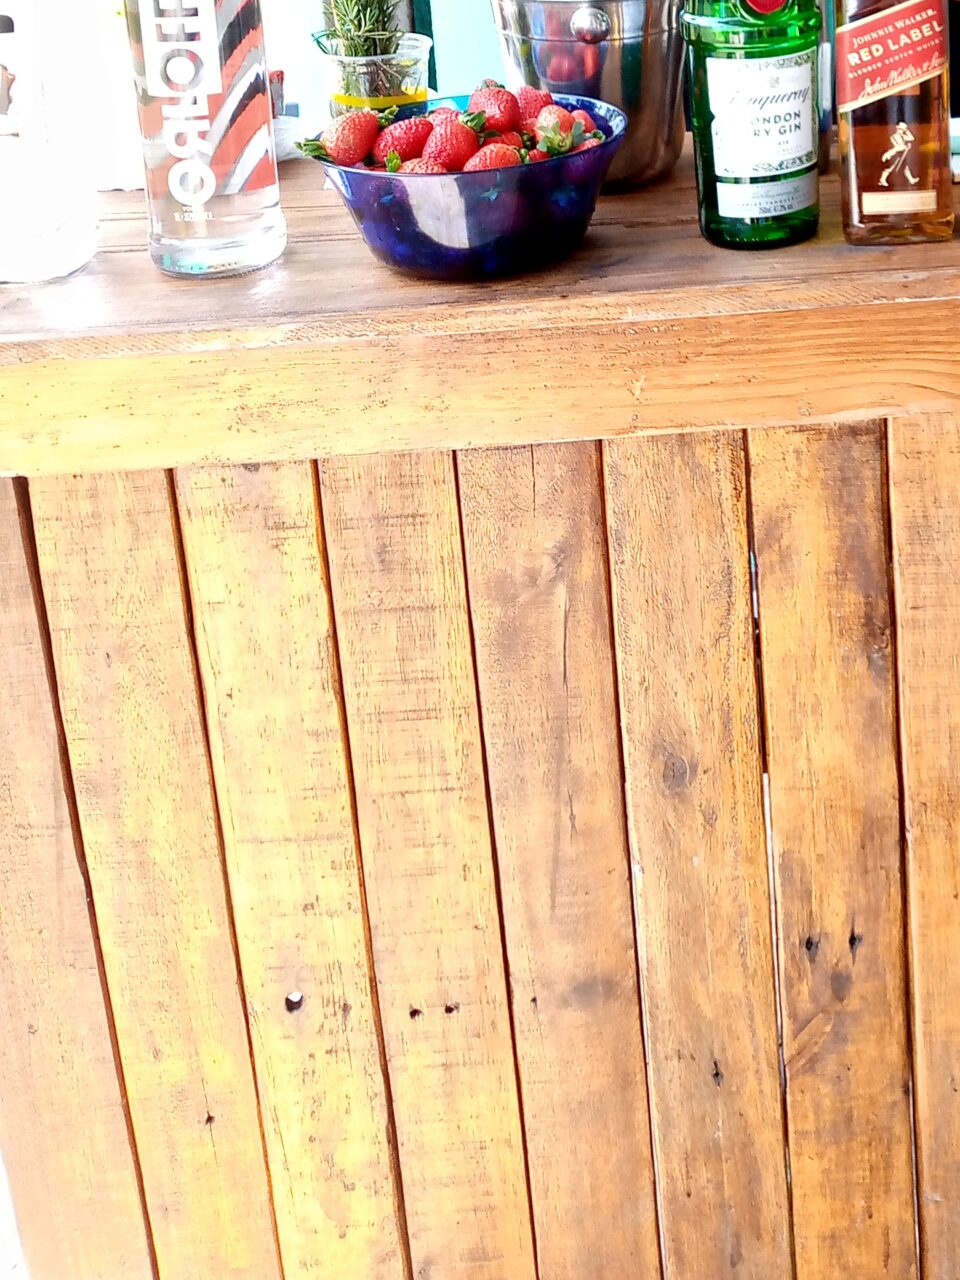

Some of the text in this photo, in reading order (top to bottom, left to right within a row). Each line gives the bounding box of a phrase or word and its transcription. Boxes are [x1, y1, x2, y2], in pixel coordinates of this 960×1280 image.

[847, 20, 943, 67] RED LABEL
[853, 24, 894, 49] JOHNNIE
[778, 121, 802, 136] GIN
